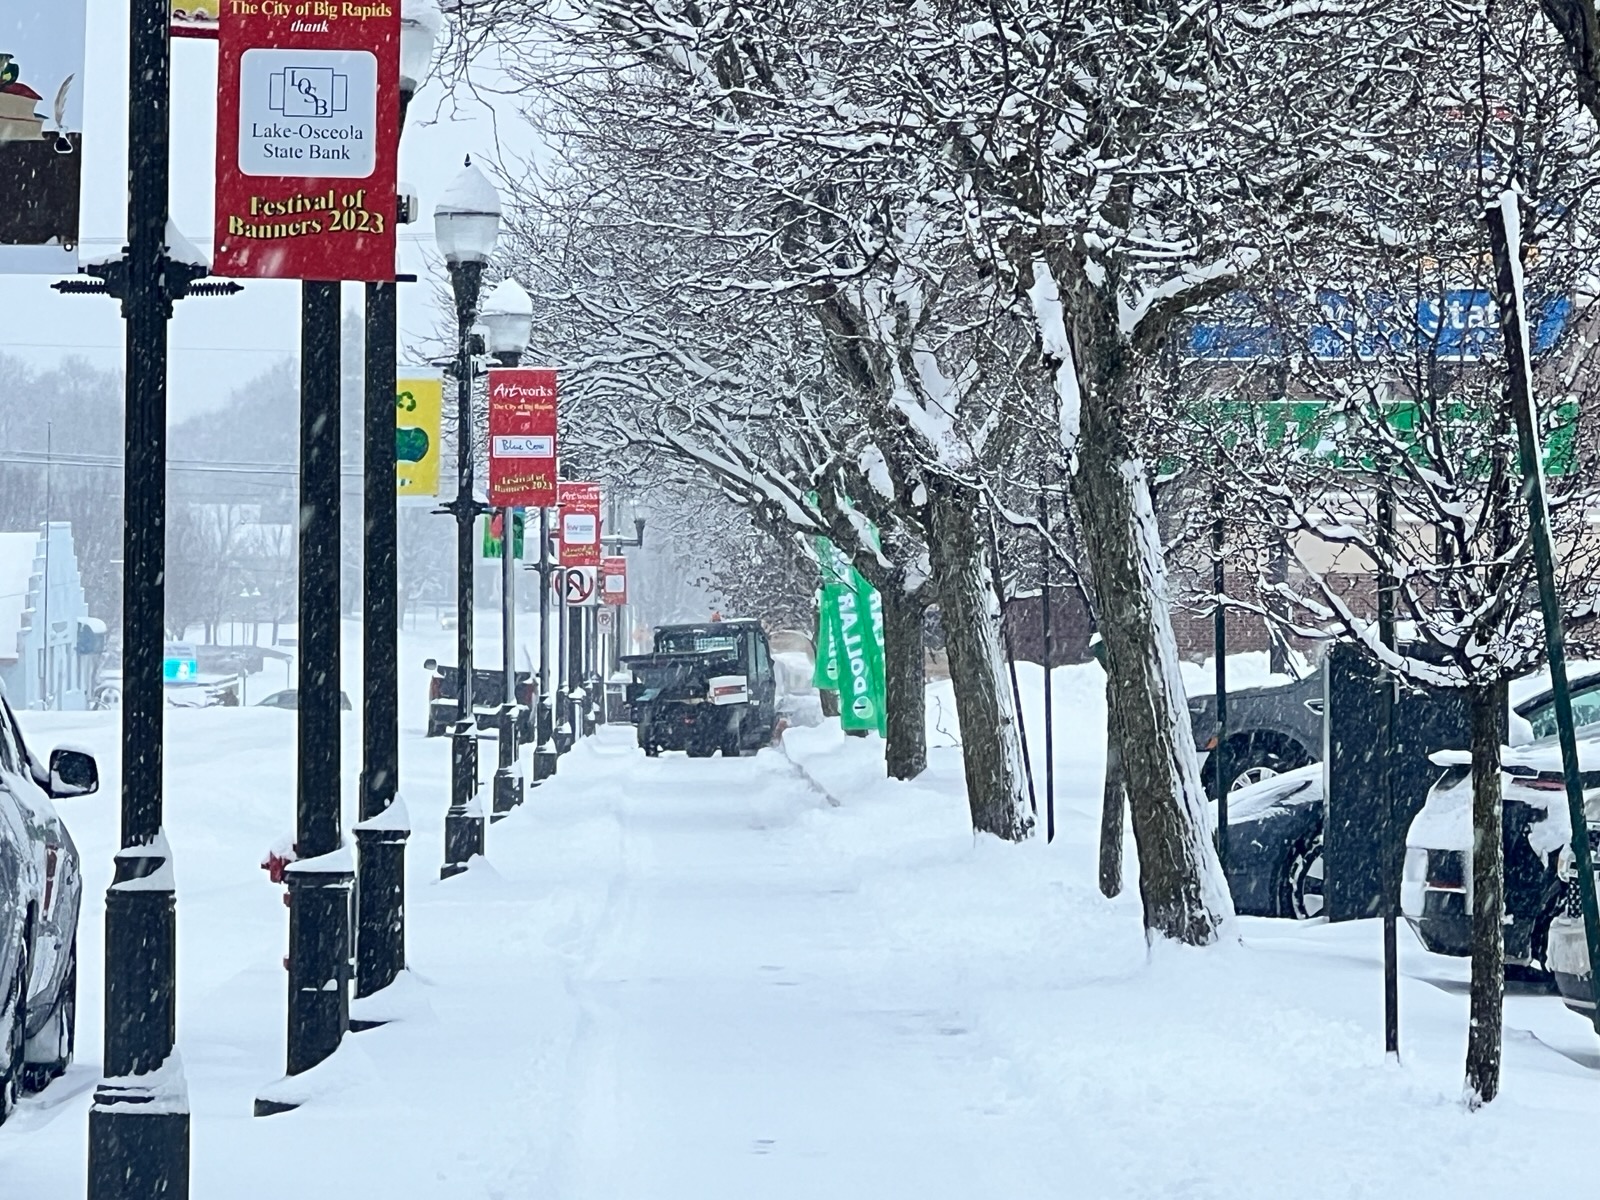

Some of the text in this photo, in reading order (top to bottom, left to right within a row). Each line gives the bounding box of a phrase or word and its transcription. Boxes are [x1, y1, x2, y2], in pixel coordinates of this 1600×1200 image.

[230, 0, 392, 21] The City of Big Rapids
[290, 20, 329, 33] thank
[252, 123, 363, 140] Lake-Osceola
[264, 143, 350, 160] State Bank
[250, 189, 366, 216] Festival of
[228, 209, 384, 239] Banners 2023
[493, 382, 554, 398] Artworks
[502, 439, 524, 451] Blue
